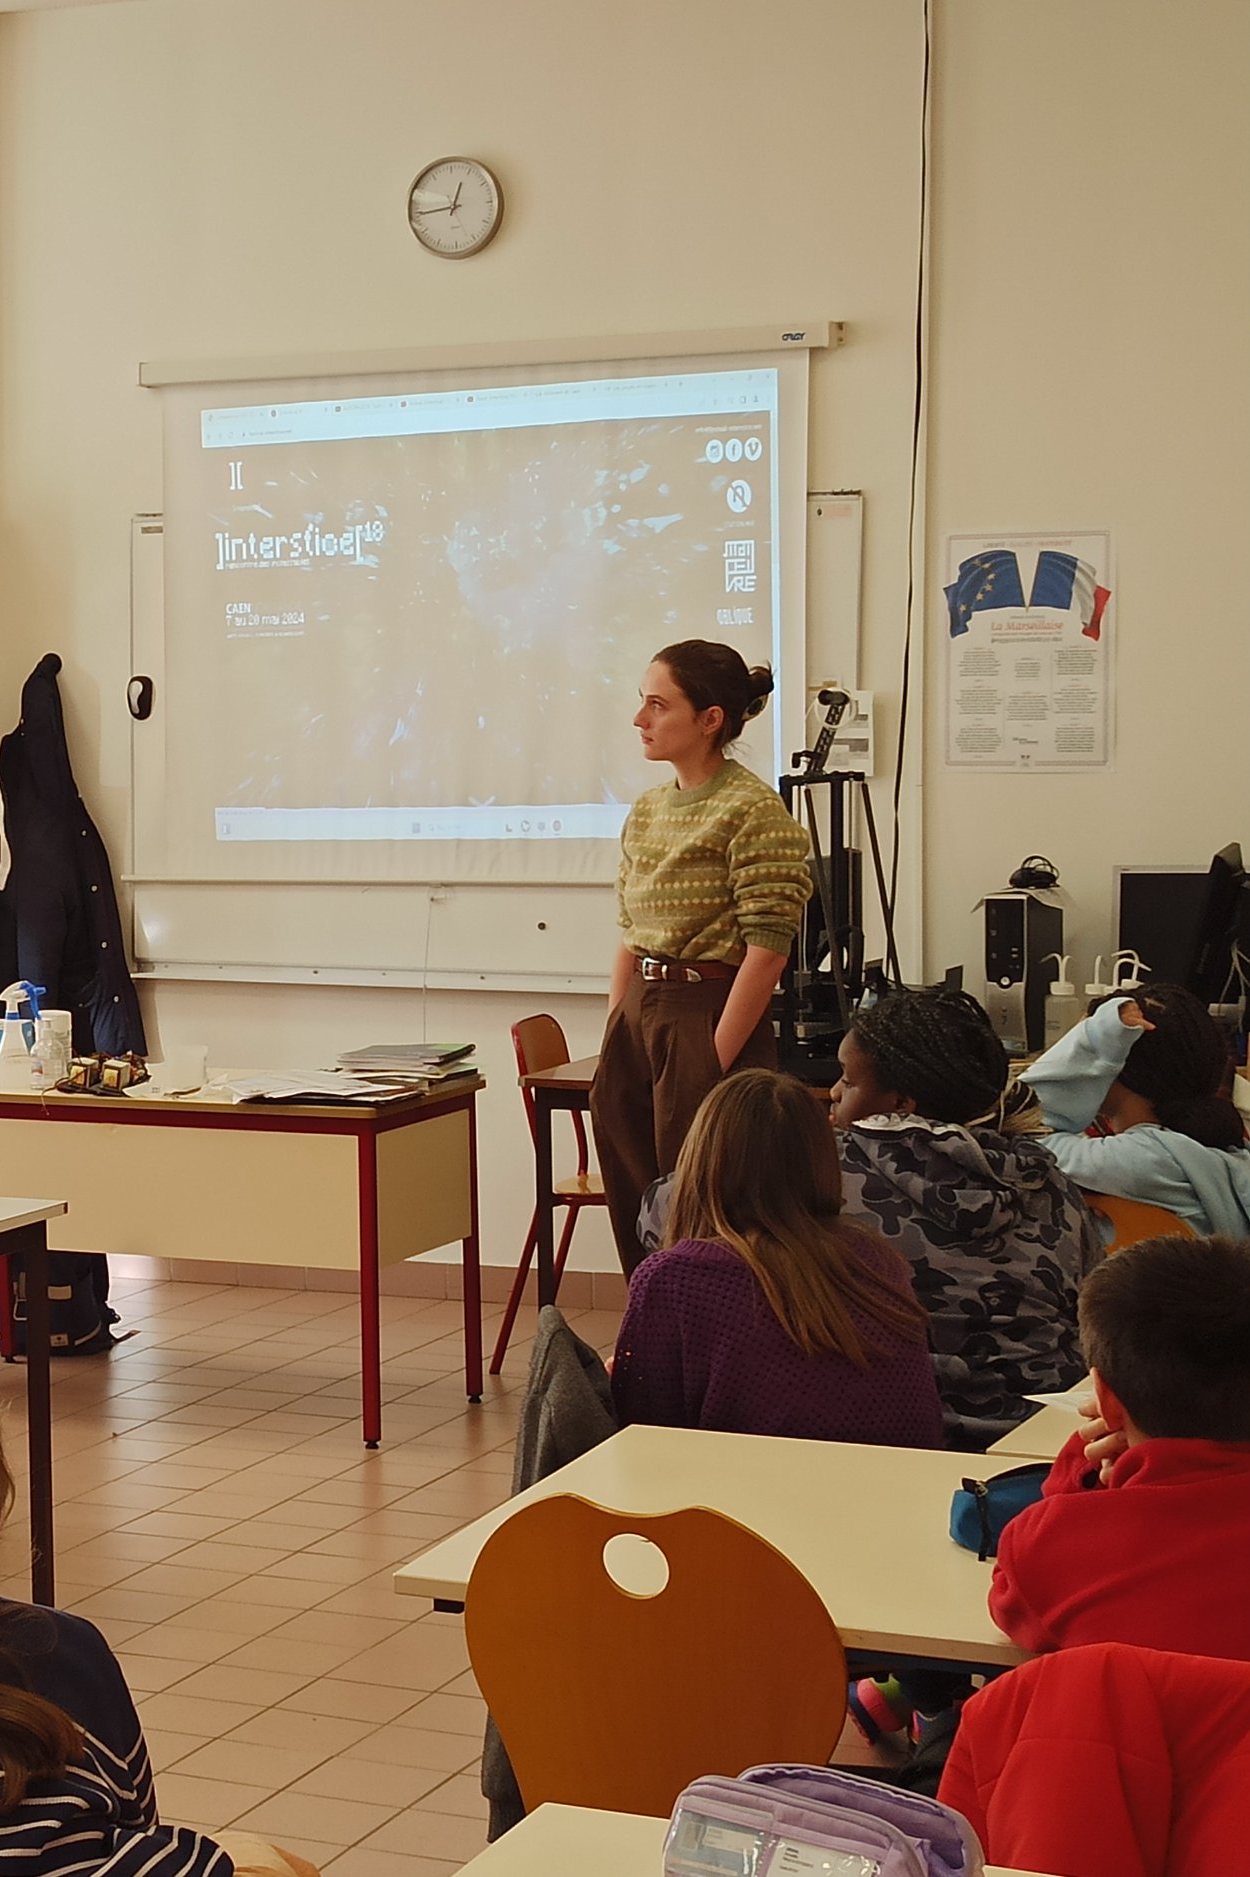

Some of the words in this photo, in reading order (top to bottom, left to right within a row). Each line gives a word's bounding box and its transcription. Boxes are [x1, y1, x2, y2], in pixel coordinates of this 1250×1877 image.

[225, 603, 251, 614] CAEN
[225, 615, 232, 626] 7
[235, 616, 247, 626] au
[248, 614, 260, 625] 20
[261, 614, 280, 625] mai
[281, 612, 305, 625] 2024
[991, 622, 1004, 632] La
[1006, 620, 1064, 632] Marseillaise
